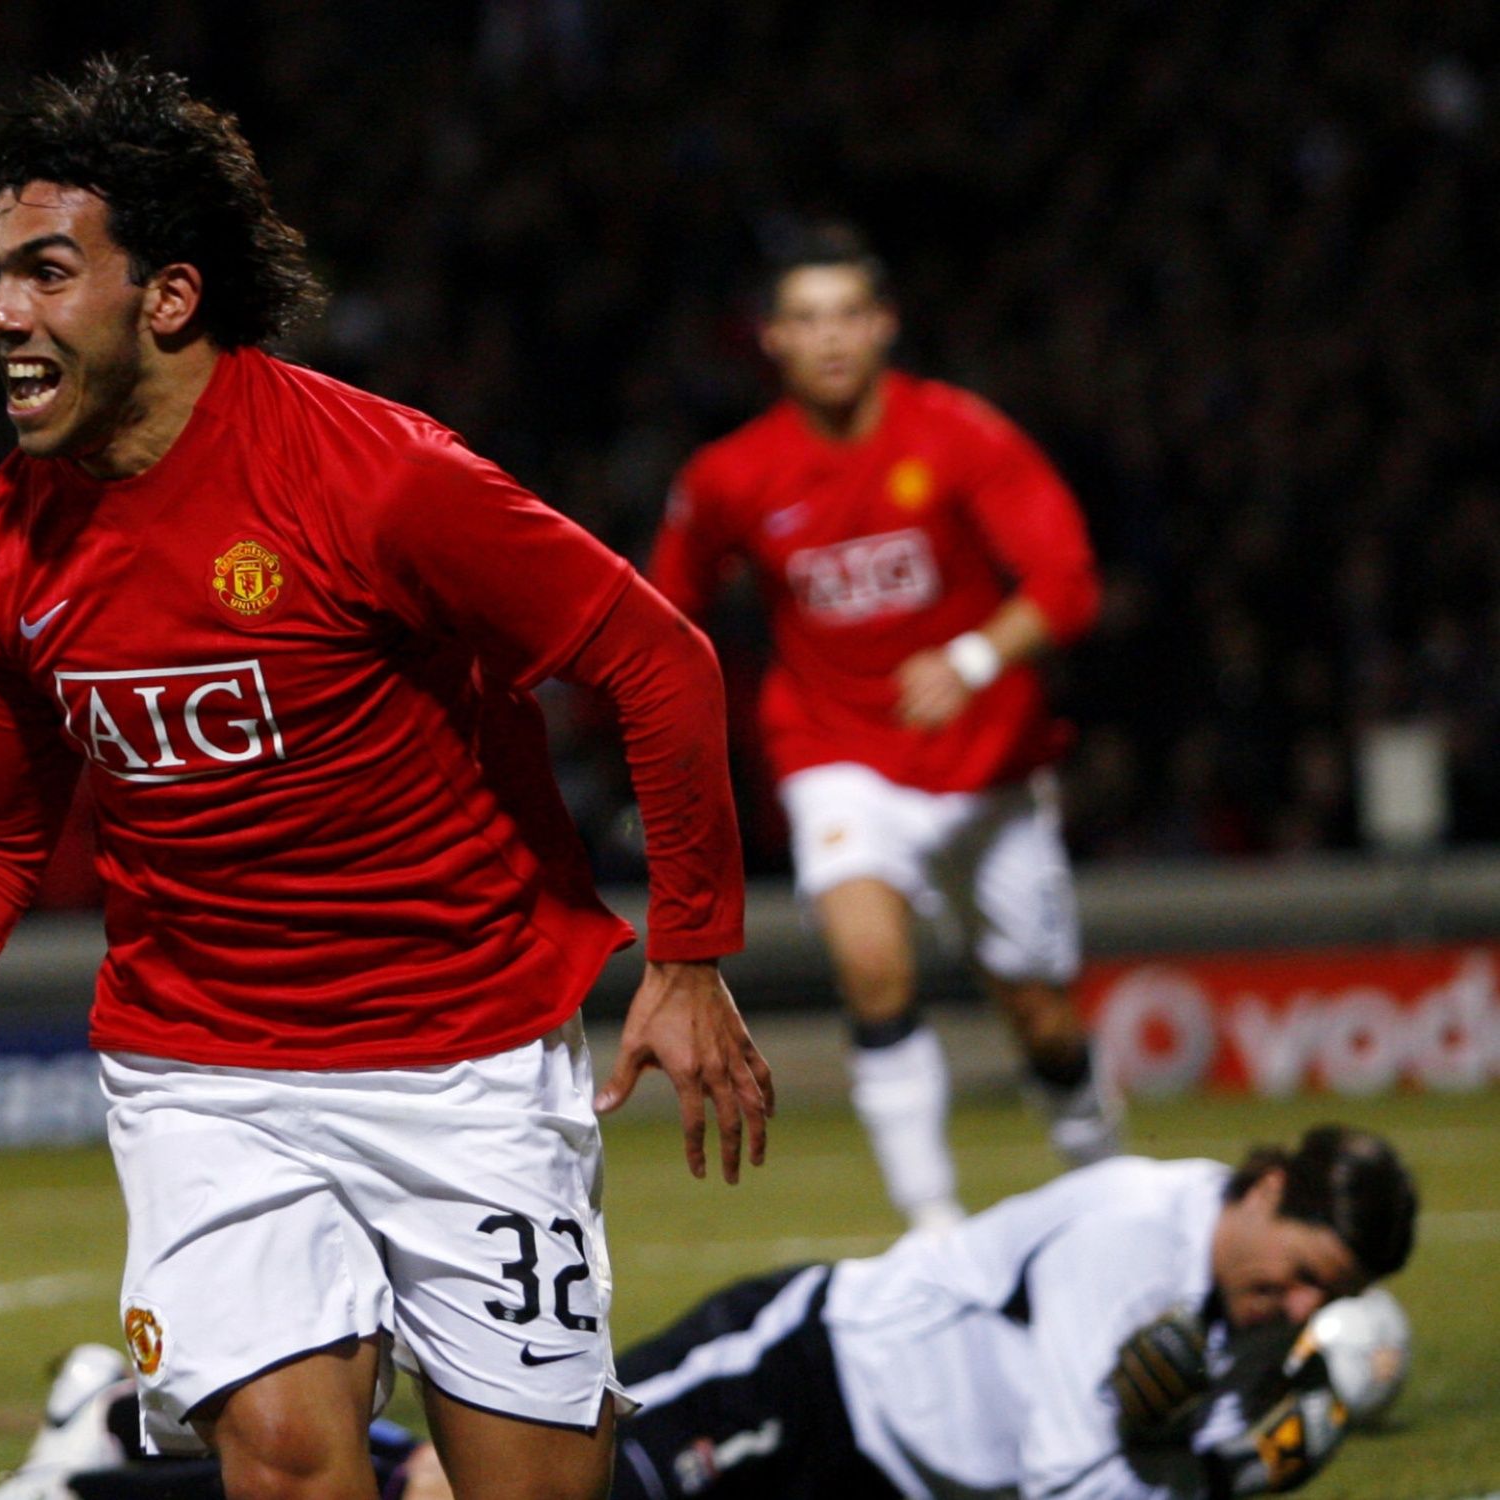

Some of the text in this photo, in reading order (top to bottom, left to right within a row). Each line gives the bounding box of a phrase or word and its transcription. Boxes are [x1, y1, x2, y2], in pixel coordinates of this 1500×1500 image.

[230, 596, 270, 610] UNITED
[89, 678, 262, 768] AIG
[1233, 946, 1500, 1098] vod
[476, 1213, 597, 1333] 32
